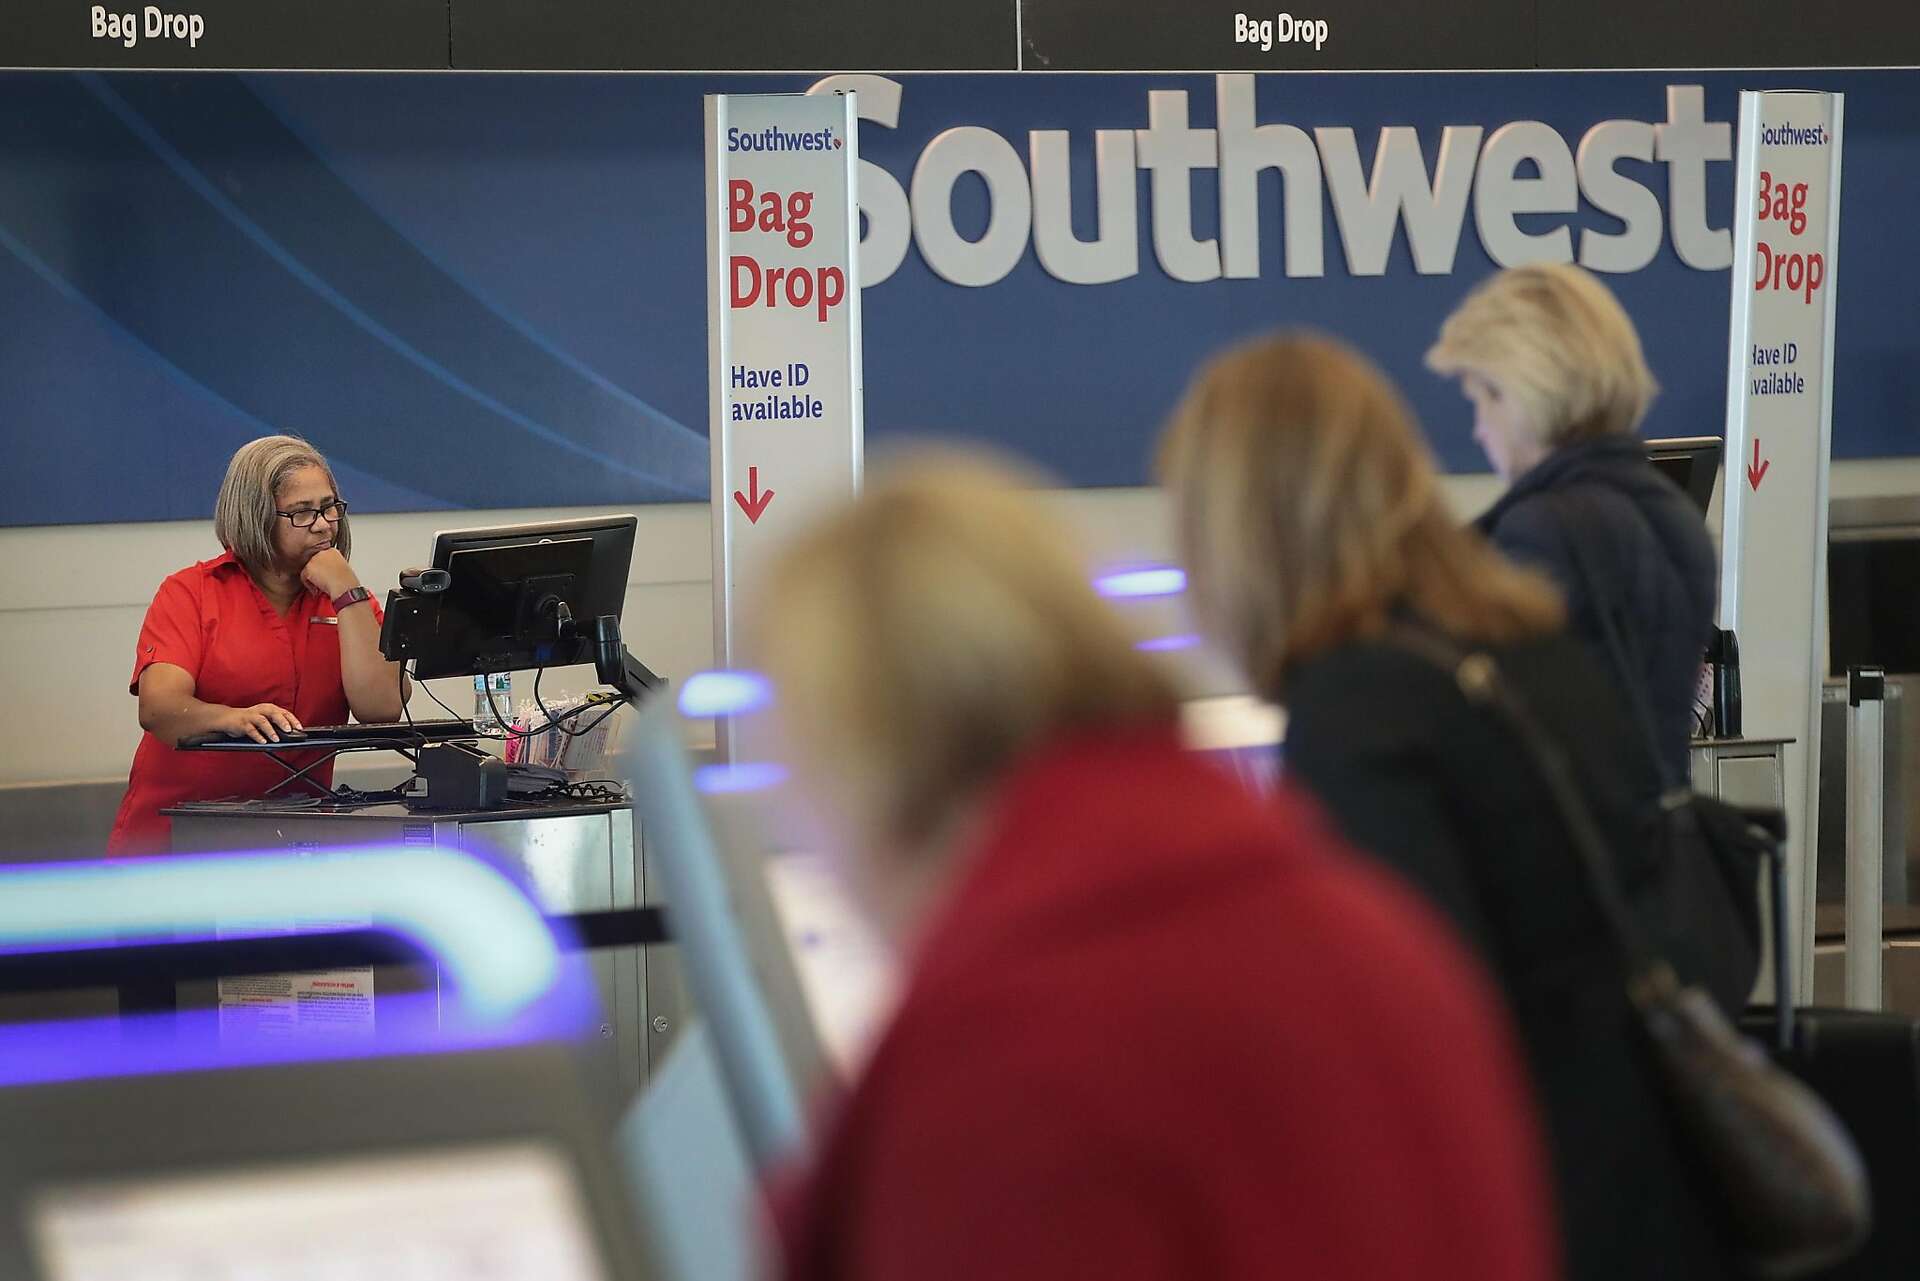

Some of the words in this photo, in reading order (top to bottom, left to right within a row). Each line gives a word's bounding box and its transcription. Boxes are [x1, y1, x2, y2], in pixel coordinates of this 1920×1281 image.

[91, 6, 136, 48] Bag
[144, 6, 204, 47] Drop
[1234, 13, 1272, 51] Bag
[1278, 13, 1328, 51] Drop
[727, 126, 832, 152] Southwest
[803, 73, 1732, 287] Southwest
[728, 179, 814, 248] Bag
[1758, 171, 1808, 235] Bag
[729, 255, 845, 323] Drop
[1755, 242, 1824, 304] Drop
[1783, 343, 1798, 364] ID
[731, 364, 783, 389] Have
[787, 363, 810, 387] ID
[1750, 371, 1805, 396] vailable
[732, 394, 823, 421] available
